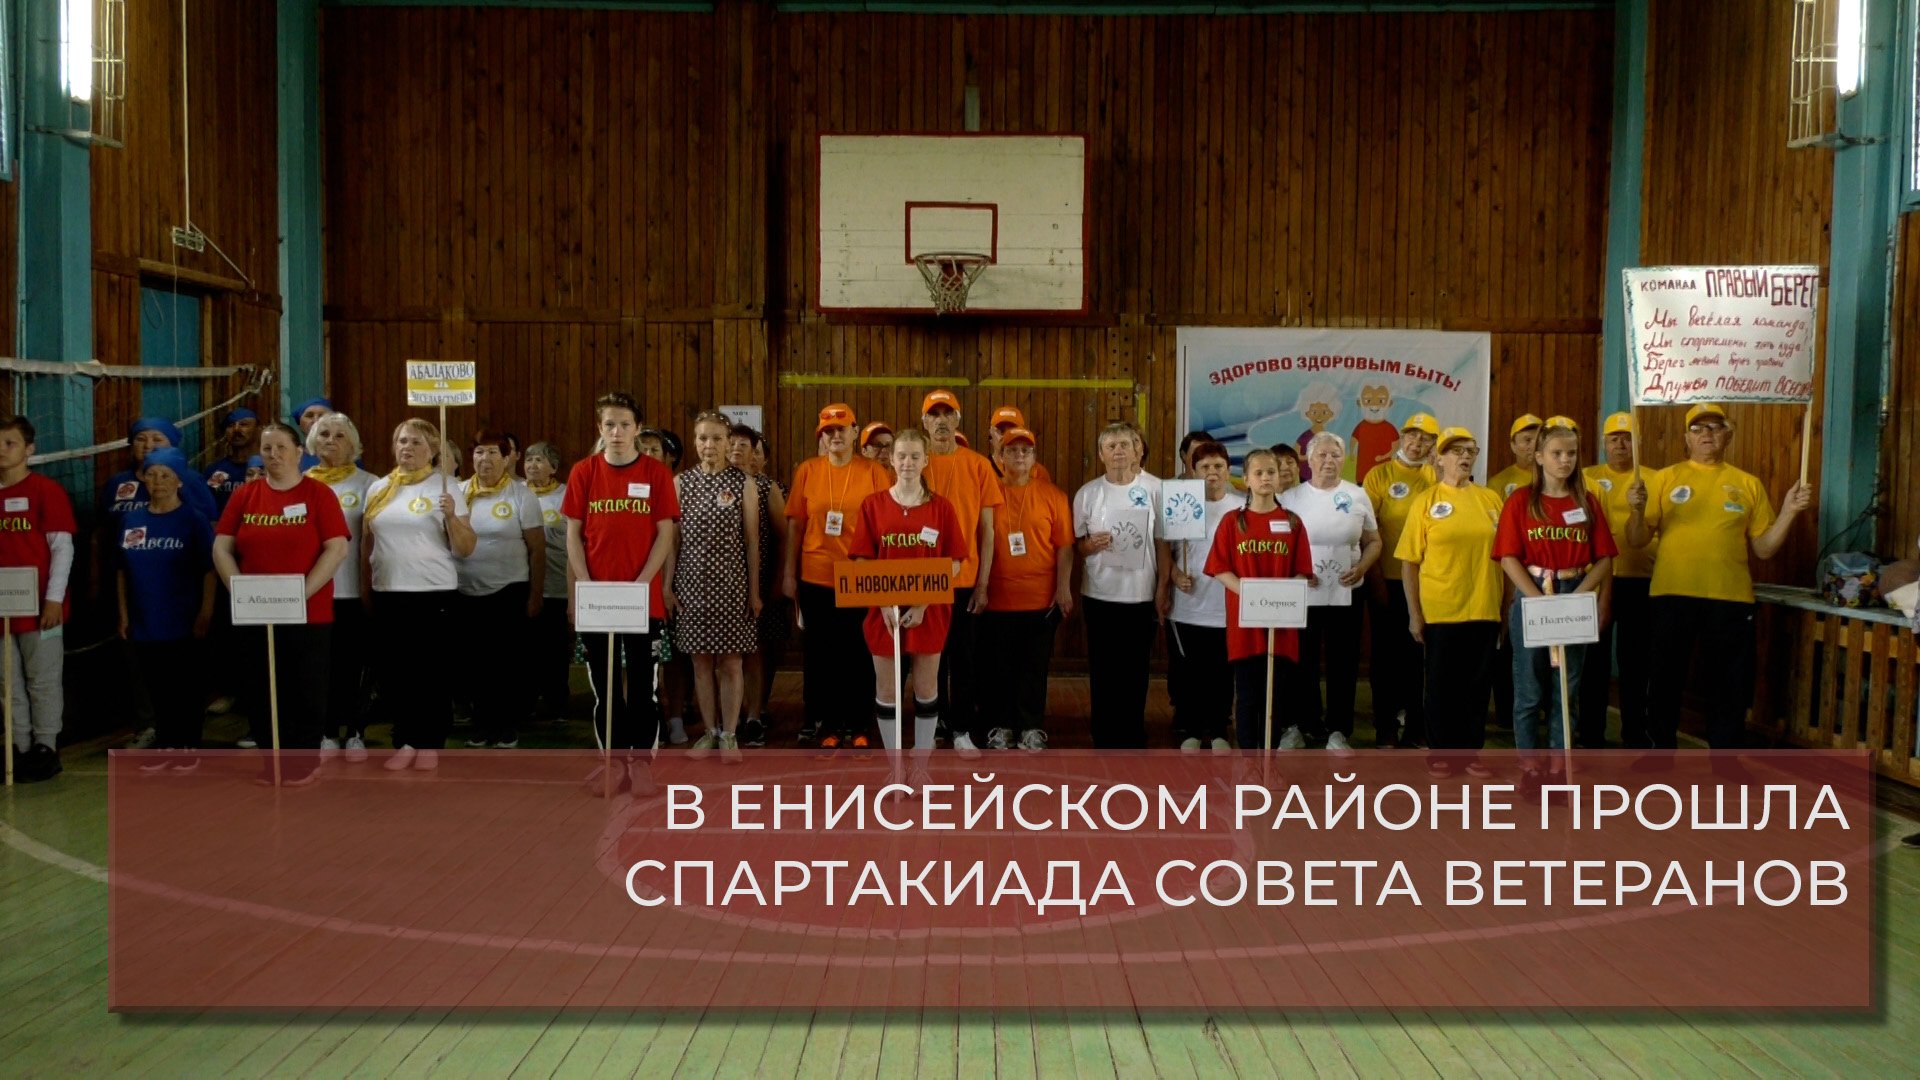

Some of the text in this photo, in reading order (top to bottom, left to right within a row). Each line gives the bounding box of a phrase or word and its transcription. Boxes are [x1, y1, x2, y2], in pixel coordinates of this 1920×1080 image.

[1641, 269, 1820, 308] КОМАНДА ПРАВЫЙ БЕРЕГ
[1645, 307, 1678, 330] Мы
[1643, 332, 1673, 351] Мы
[410, 363, 474, 379] АБАЛАКОВО
[1209, 355, 1462, 392] ЗДОРОВО ЗДОРОВЫМ БЫТЬ!
[589, 499, 651, 514] МЕДВЕДЬ
[1527, 525, 1588, 542] МЕДВЕДЬ
[840, 573, 949, 594] П. НОВОКАРГИНО
[248, 595, 300, 604] Абалаково
